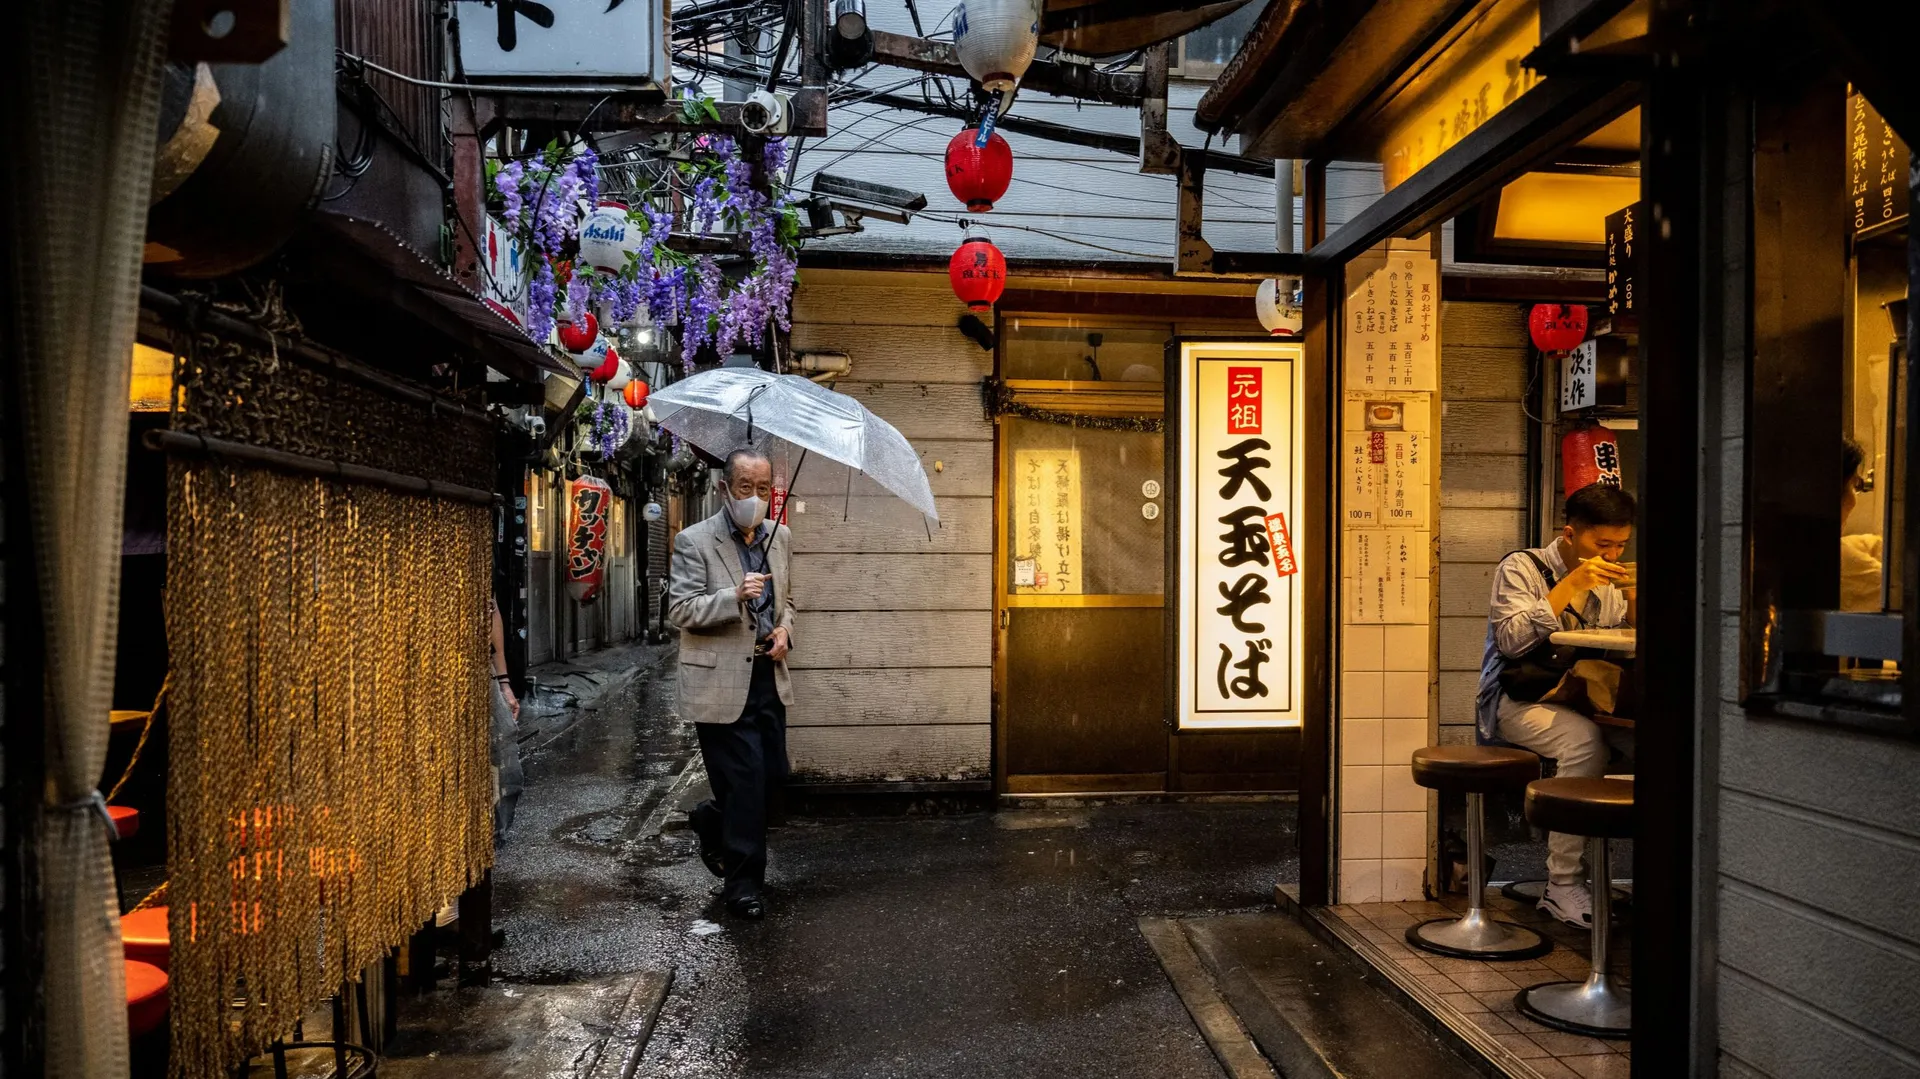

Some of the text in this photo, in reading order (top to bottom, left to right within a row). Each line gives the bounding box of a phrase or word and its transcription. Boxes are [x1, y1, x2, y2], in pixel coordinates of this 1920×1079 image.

[583, 223, 626, 242] Asahi
[1624, 208, 1634, 259] 大盛り
[962, 269, 1001, 279] BLACK
[1365, 271, 1375, 384] 冷しきつねそば 五百十円
[1388, 272, 1398, 385] 冷したぬきそば 五百十円
[1404, 272, 1414, 385] 冷し天玉そば 五百三十円
[1421, 283, 1430, 342] 夏のおすすめ
[1545, 321, 1582, 330] BLACK
[1231, 373, 1259, 429] 元祖
[1570, 348, 1586, 406] 次作
[1354, 445, 1363, 495] 鮭おにぎり
[1395, 443, 1404, 508] 五目いなり寿司
[1410, 434, 1418, 464] ジャンボ
[1349, 510, 1362, 519] 100
[1390, 509, 1403, 518] 100
[1216, 438, 1273, 700] 天玉そば
